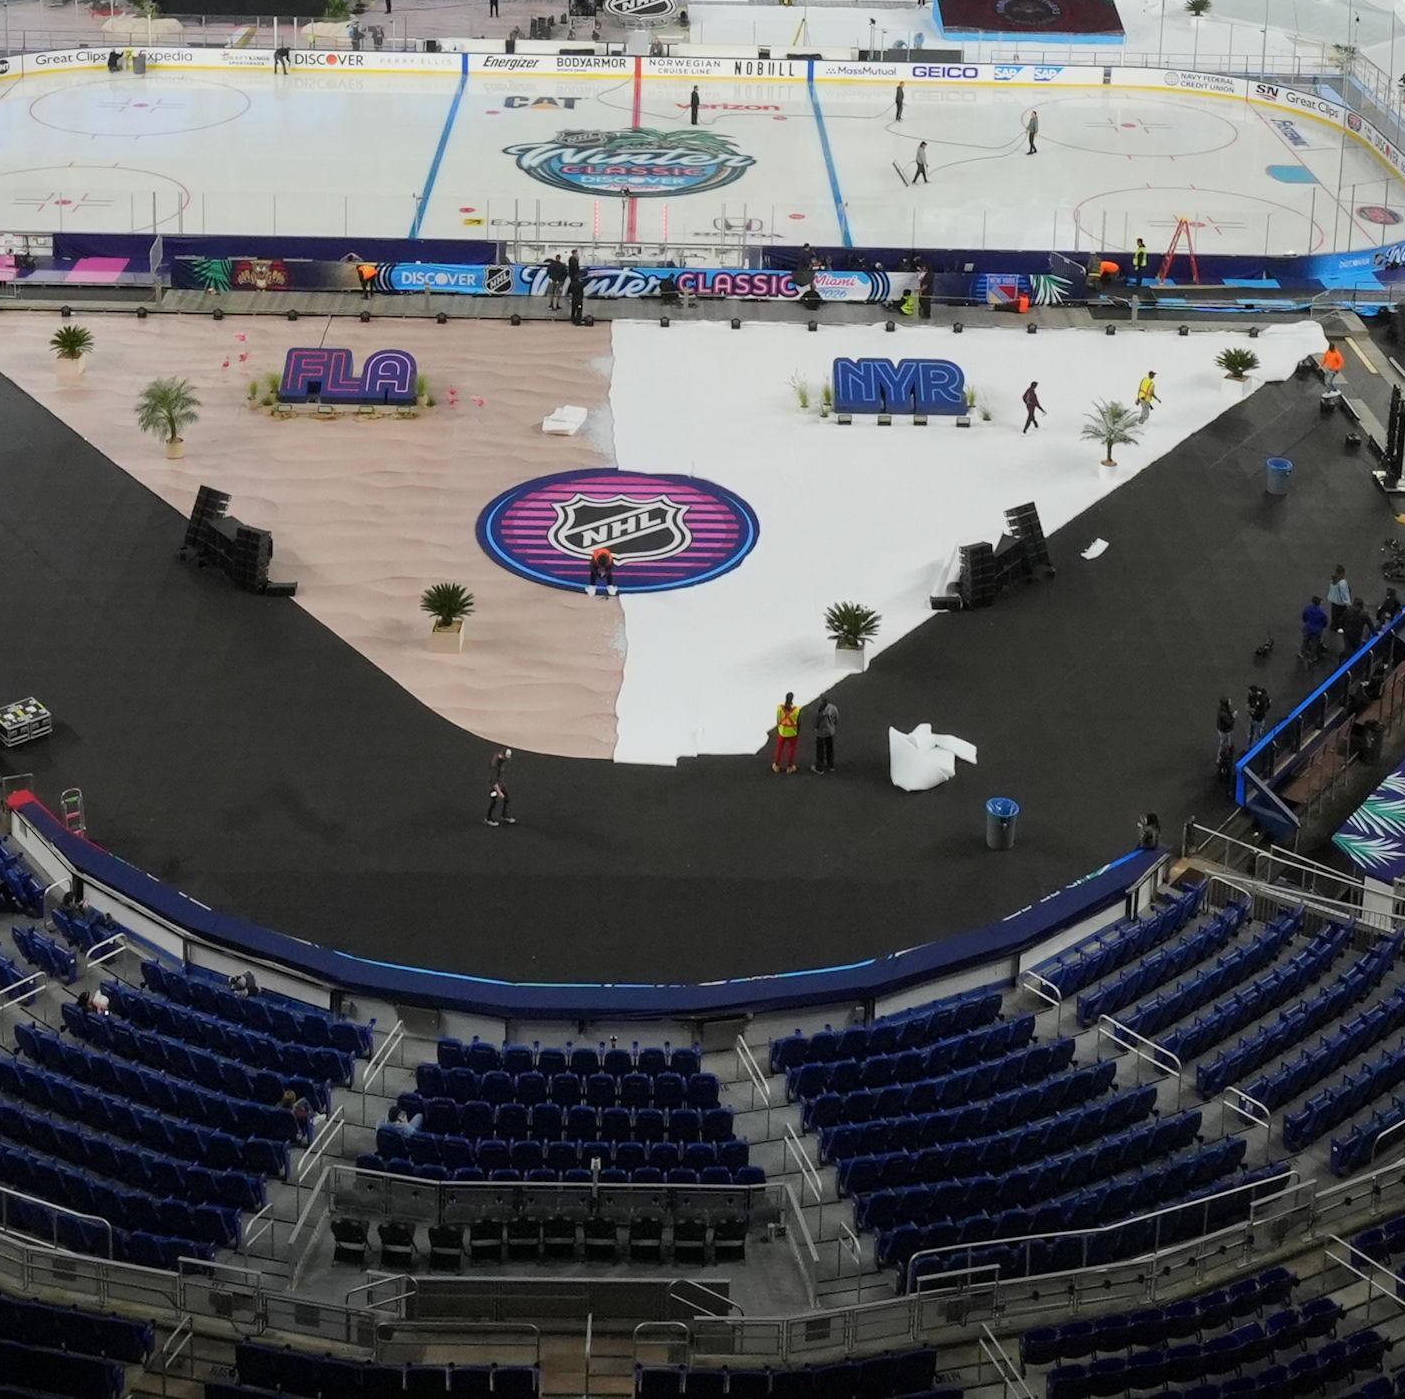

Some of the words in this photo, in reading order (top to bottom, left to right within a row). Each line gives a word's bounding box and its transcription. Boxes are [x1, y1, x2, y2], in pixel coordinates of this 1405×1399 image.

[35, 53, 74, 66] Great
[75, 49, 107, 65] Clips
[294, 52, 364, 67] DISCOVER
[379, 57, 417, 66] PERRY
[419, 57, 453, 66] ELLIS
[482, 55, 540, 71] Energizer
[556, 57, 627, 69] BODYARMOR
[648, 58, 722, 69] NORWEGIAN
[656, 67, 686, 75] CRUISE
[686, 68, 711, 76] LINE
[734, 60, 795, 77] NOBULL
[837, 65, 897, 76] MassMutual
[911, 65, 979, 79] GEICO
[994, 67, 1017, 80] SAP
[1034, 67, 1056, 81] SAP
[1180, 72, 1202, 83] NAVY
[1203, 74, 1235, 86] FEDERAL
[1180, 80, 1208, 92] CREDIT
[1209, 82, 1235, 94] UNION
[1255, 83, 1280, 97] SN
[502, 96, 584, 110] CAT
[1285, 90, 1317, 109] Great
[1317, 99, 1340, 119] Clips
[502, 143, 758, 172] Winter
[561, 164, 707, 177] CLASSIC
[580, 175, 686, 185] DISCOVER
[490, 217, 585, 228] Expedia
[401, 270, 477, 288] DISCOVER
[675, 271, 799, 299] CLASSIC
[811, 272, 857, 288] Miami
[285, 349, 415, 396] FLA
[835, 359, 965, 404] NYR
[581, 507, 661, 550] NHL
